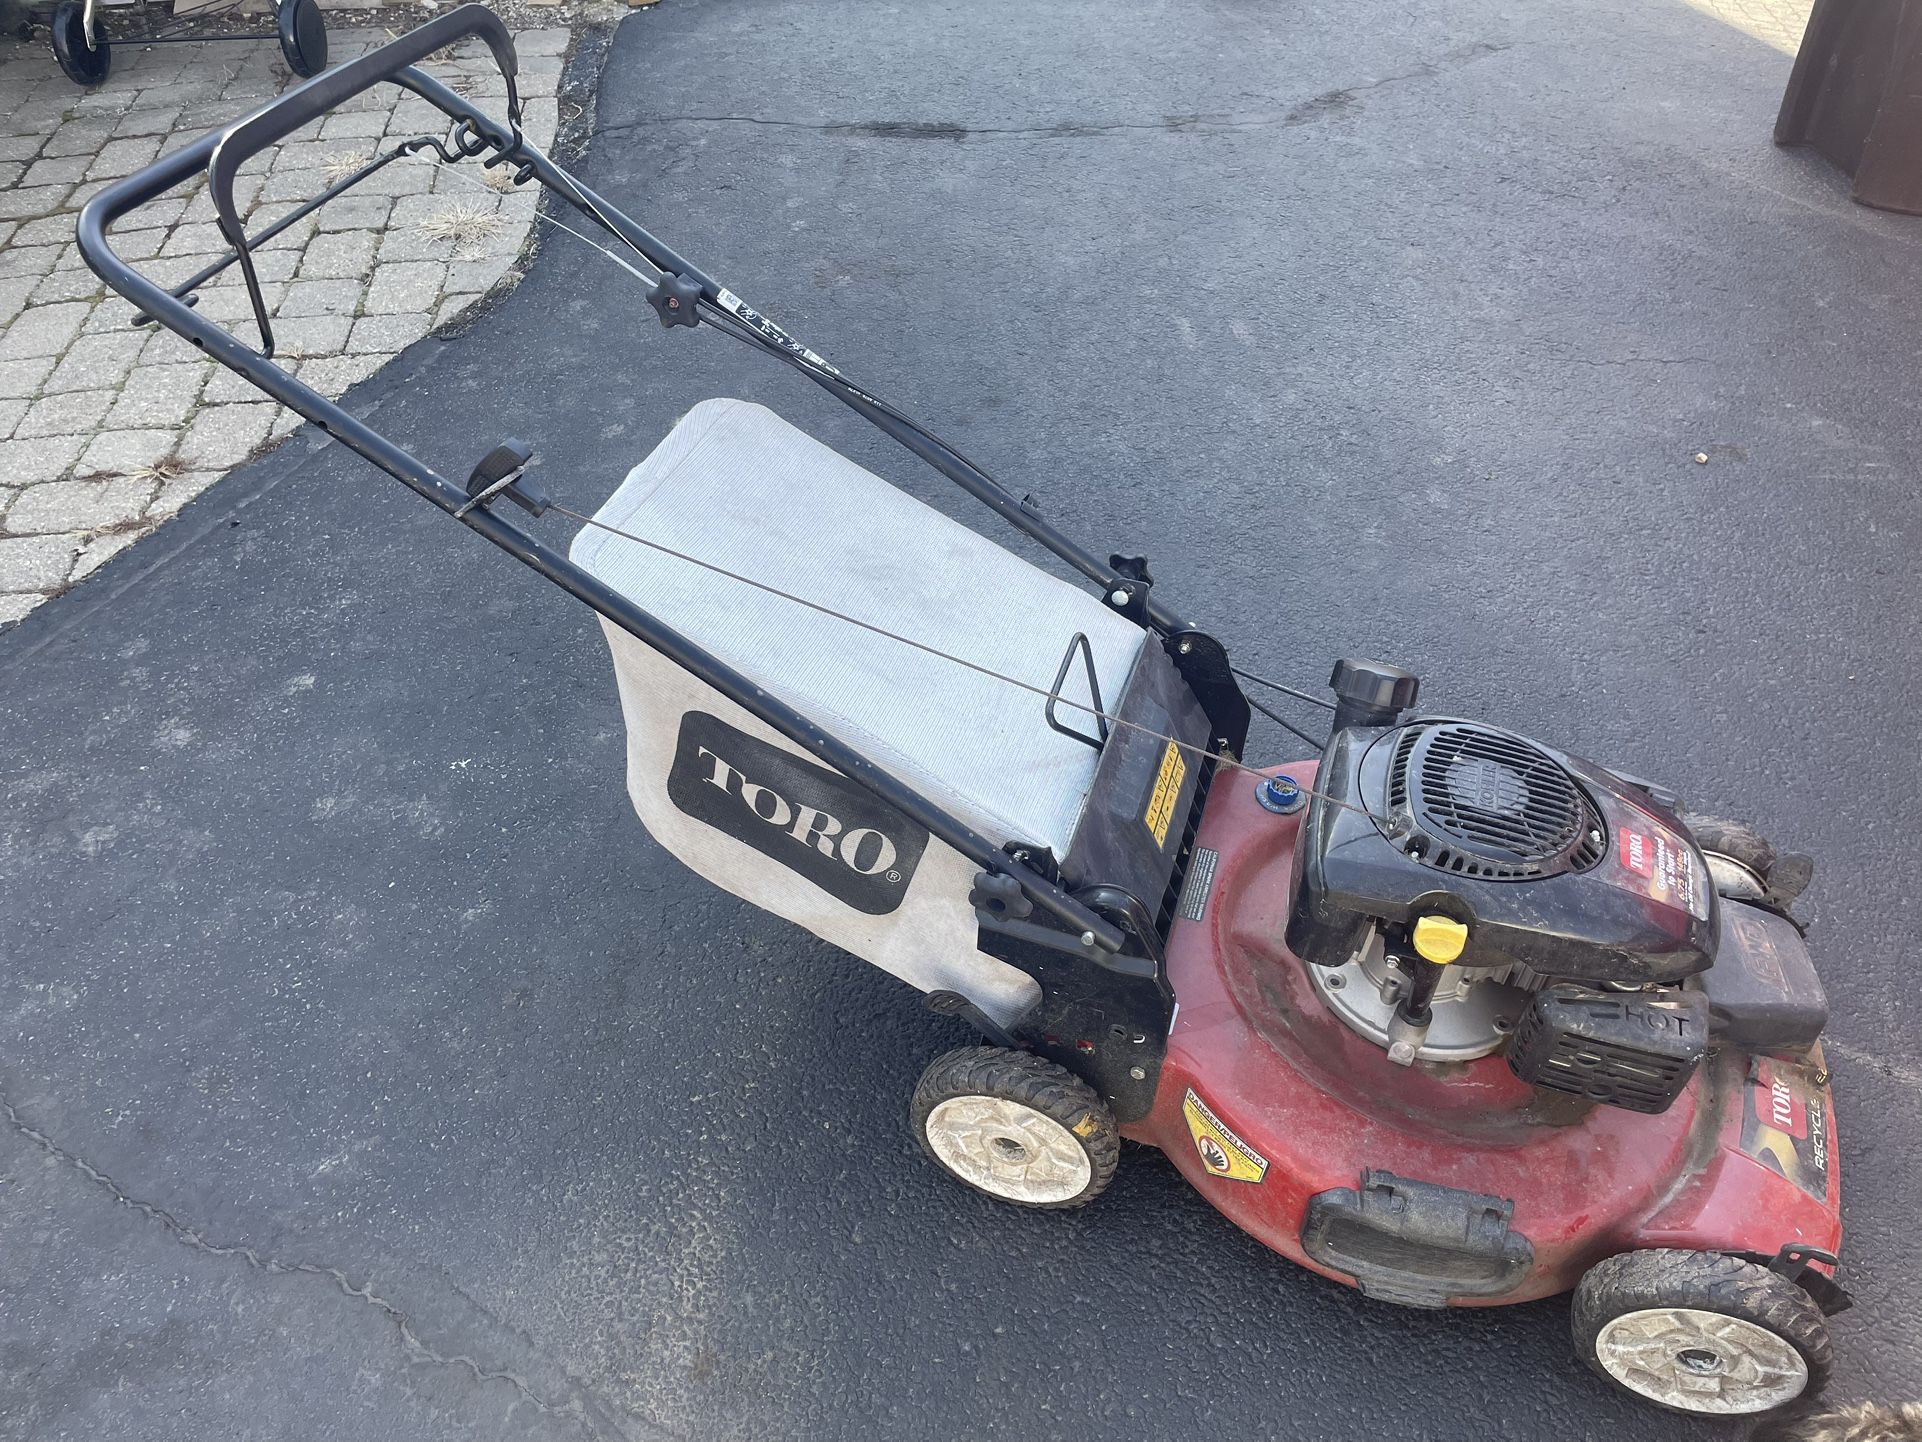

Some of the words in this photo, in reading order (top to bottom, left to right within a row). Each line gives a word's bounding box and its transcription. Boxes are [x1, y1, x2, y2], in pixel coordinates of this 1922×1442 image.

[699, 745, 897, 875] TORO
[1630, 834, 1643, 870] TORO
[1655, 837, 1665, 890] Guaranteed
[1625, 1004, 1690, 1037] HOT
[1810, 1097, 1825, 1171] RECYCLE
